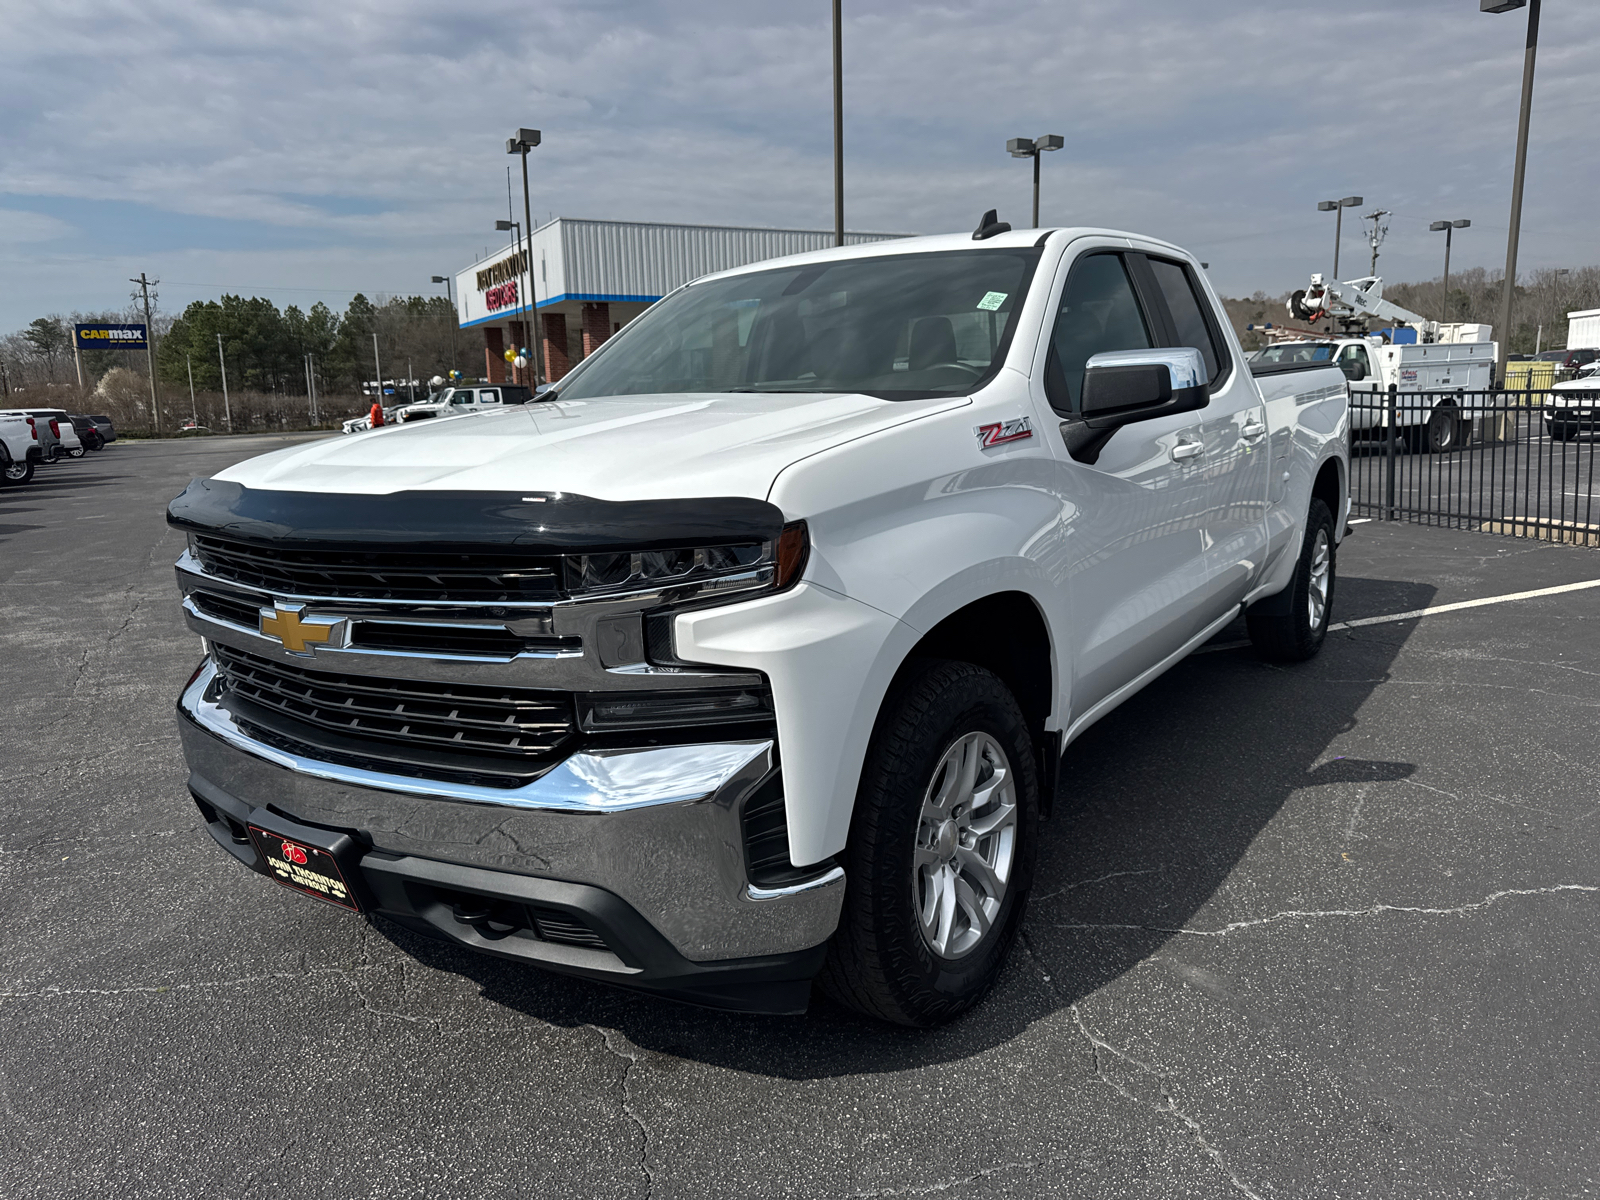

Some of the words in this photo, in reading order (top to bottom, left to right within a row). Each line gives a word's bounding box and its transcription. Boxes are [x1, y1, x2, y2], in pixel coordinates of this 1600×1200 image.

[973, 416, 1033, 451] Z71
[267, 856, 293, 873] JOHN
[292, 865, 347, 893] THORNTON
[291, 874, 329, 893] CHEVROLET
